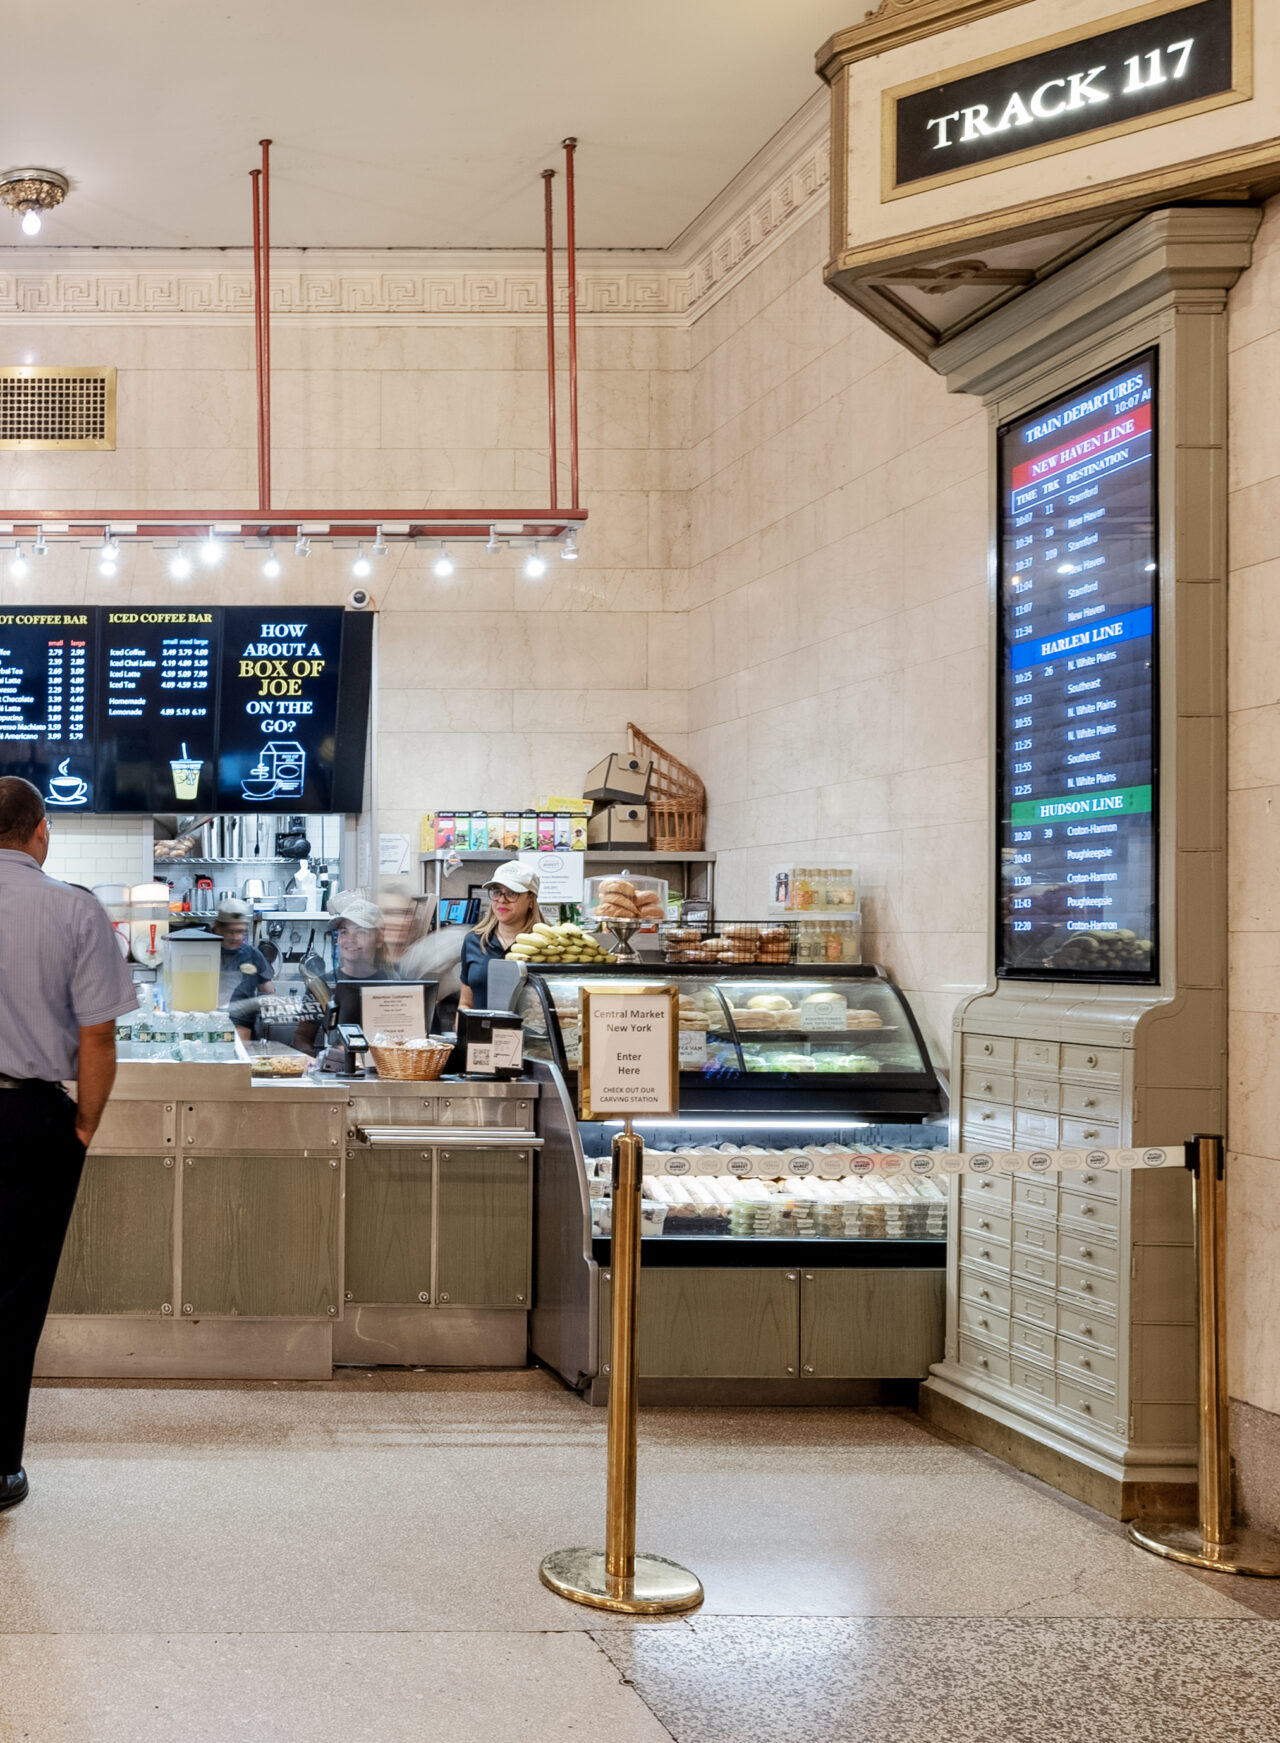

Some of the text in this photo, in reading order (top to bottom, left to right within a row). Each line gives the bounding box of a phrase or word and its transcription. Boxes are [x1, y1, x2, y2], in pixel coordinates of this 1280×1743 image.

[926, 37, 1195, 151] TRACK 117
[1025, 374, 1143, 443] TRAIN DEPARTURES
[1114, 394, 1139, 415] 10:07
[1031, 420, 1134, 476] NEW HAVEN LINE
[1016, 449, 1129, 505] TIME TRK DESTINATION
[1045, 504, 1054, 515] 11
[1067, 485, 1099, 505] Stamford
[1067, 517, 1083, 529] New
[1083, 508, 1106, 523] Haven
[1067, 533, 1099, 552] Stamford
[1083, 556, 1106, 570] Haven
[1067, 580, 1099, 599] Stamford
[16, 615, 61, 625] COFFEE
[63, 615, 88, 625] BAR
[109, 614, 213, 623] ICED COFFEE BAR
[260, 624, 308, 638] HOW
[71, 640, 86, 648] large
[1041, 622, 1123, 656] HARLEM LINE
[124, 648, 146, 656] Coffee
[243, 643, 322, 656] ABOUT A
[124, 659, 139, 667] Chai
[238, 660, 325, 677] BOX OF
[1044, 666, 1054, 677] 26
[1076, 655, 1096, 668] White
[1096, 651, 1117, 664] Plains
[109, 670, 124, 678] Iced
[109, 681, 136, 689] Iced Tea
[258, 679, 302, 696] JOE
[1014, 678, 1101, 707] 10:53 Southeast
[108, 708, 143, 716] Lemonade
[246, 701, 313, 715] ON THE
[1014, 717, 1032, 729] 10:55
[1076, 703, 1096, 716] White
[1096, 699, 1117, 712] Plains
[261, 720, 296, 733] GO?
[1014, 750, 1101, 773] 11:55 Southeast
[1040, 796, 1123, 817] HUDSON LINE
[1043, 829, 1052, 839] 39
[1067, 822, 1117, 836] Croton-Harmon
[1067, 847, 1112, 861] Poughkeepsie
[1067, 872, 1117, 884] Croton-Harmon
[1067, 896, 1112, 909] Poughkeepsie
[260, 1002, 323, 1019] MARKET
[594, 1010, 665, 1019] Central Market
[606, 1024, 652, 1032] New York
[617, 1052, 642, 1061] Enter
[618, 1066, 641, 1075] Here
